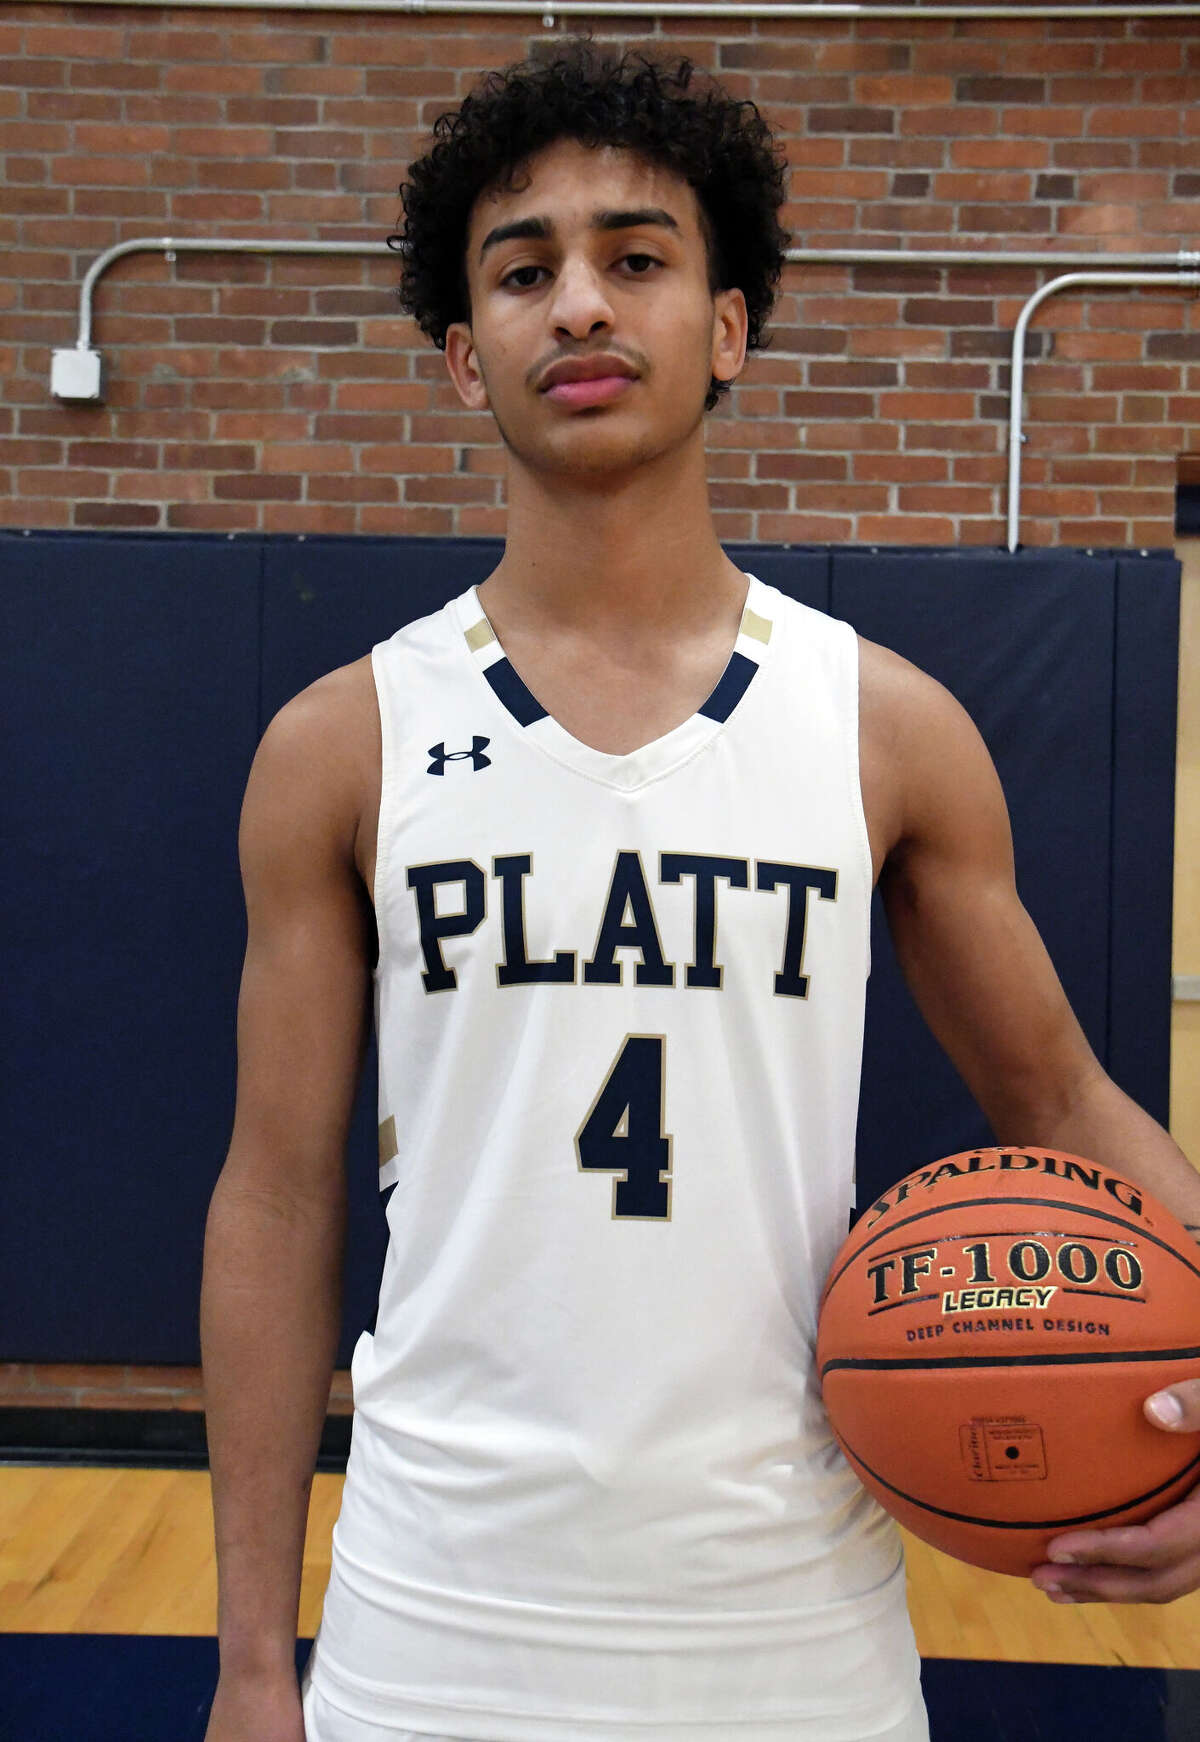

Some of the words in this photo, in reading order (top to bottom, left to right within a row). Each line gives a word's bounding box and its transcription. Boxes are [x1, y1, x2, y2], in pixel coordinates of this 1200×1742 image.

[405, 848, 839, 1000] PLATT
[573, 1032, 674, 1222] 4
[867, 1153, 1143, 1229] SPALDING
[867, 1239, 1143, 1304] TF-1000
[942, 1286, 1058, 1315] LEGACY
[906, 1324, 944, 1342] DEEP
[952, 1318, 1034, 1334] CHANNEL
[1043, 1319, 1110, 1336] DESIGN
